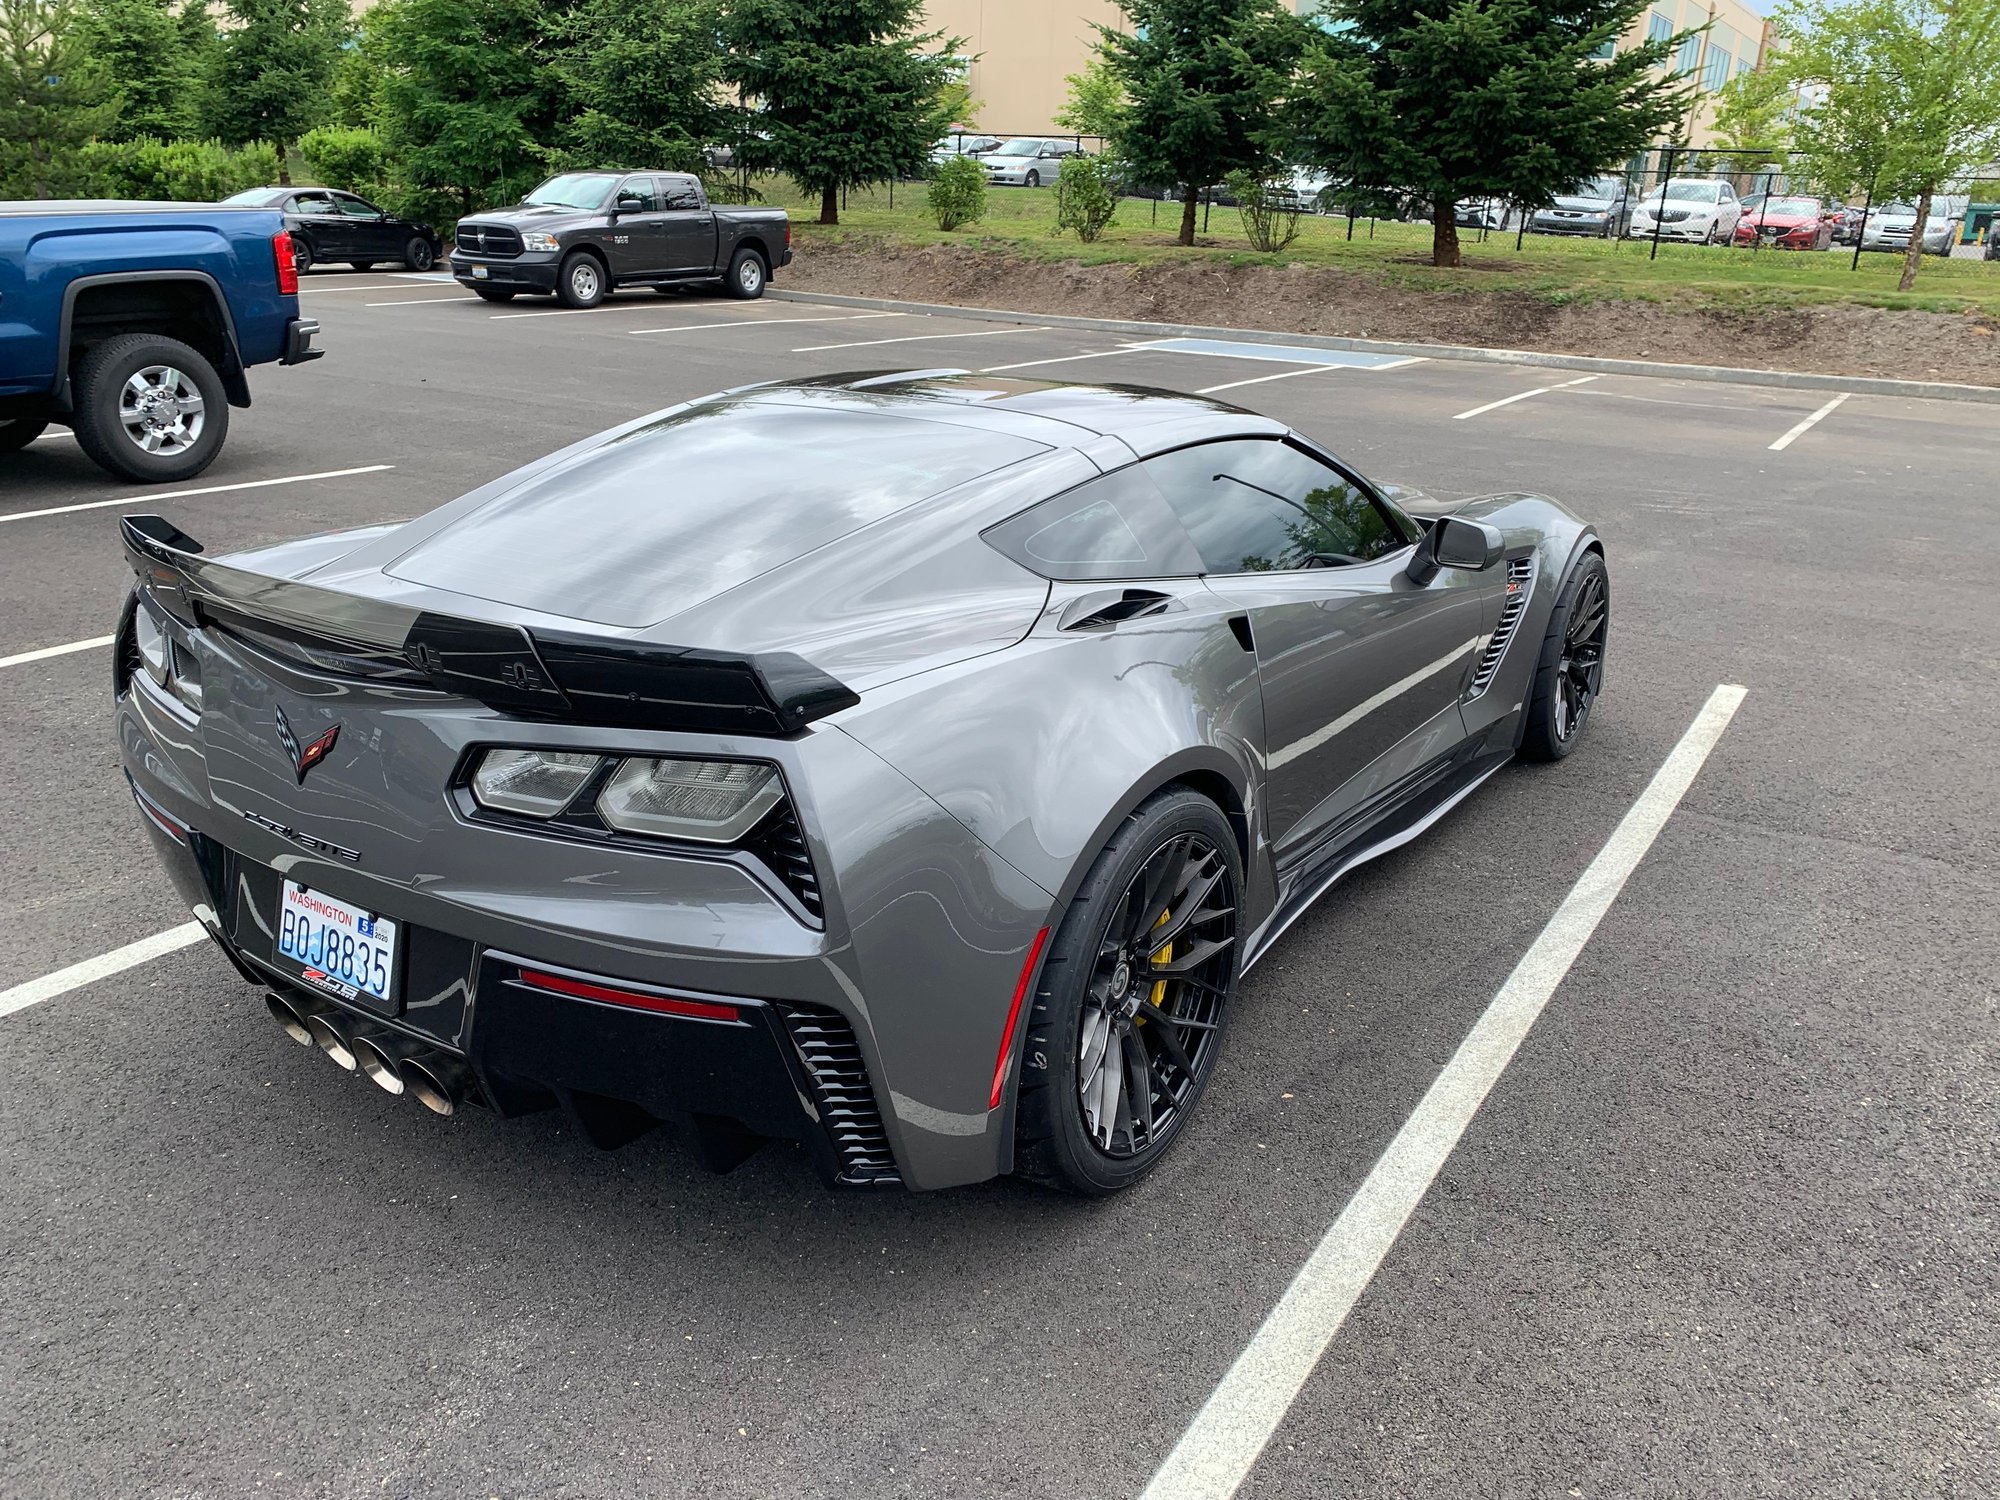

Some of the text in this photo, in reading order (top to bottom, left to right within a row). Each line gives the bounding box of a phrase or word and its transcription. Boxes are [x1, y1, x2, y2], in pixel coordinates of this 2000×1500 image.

[245, 810, 361, 862] CORVETTE
[288, 889, 352, 927] WASHINGTON
[361, 919, 369, 932] 5
